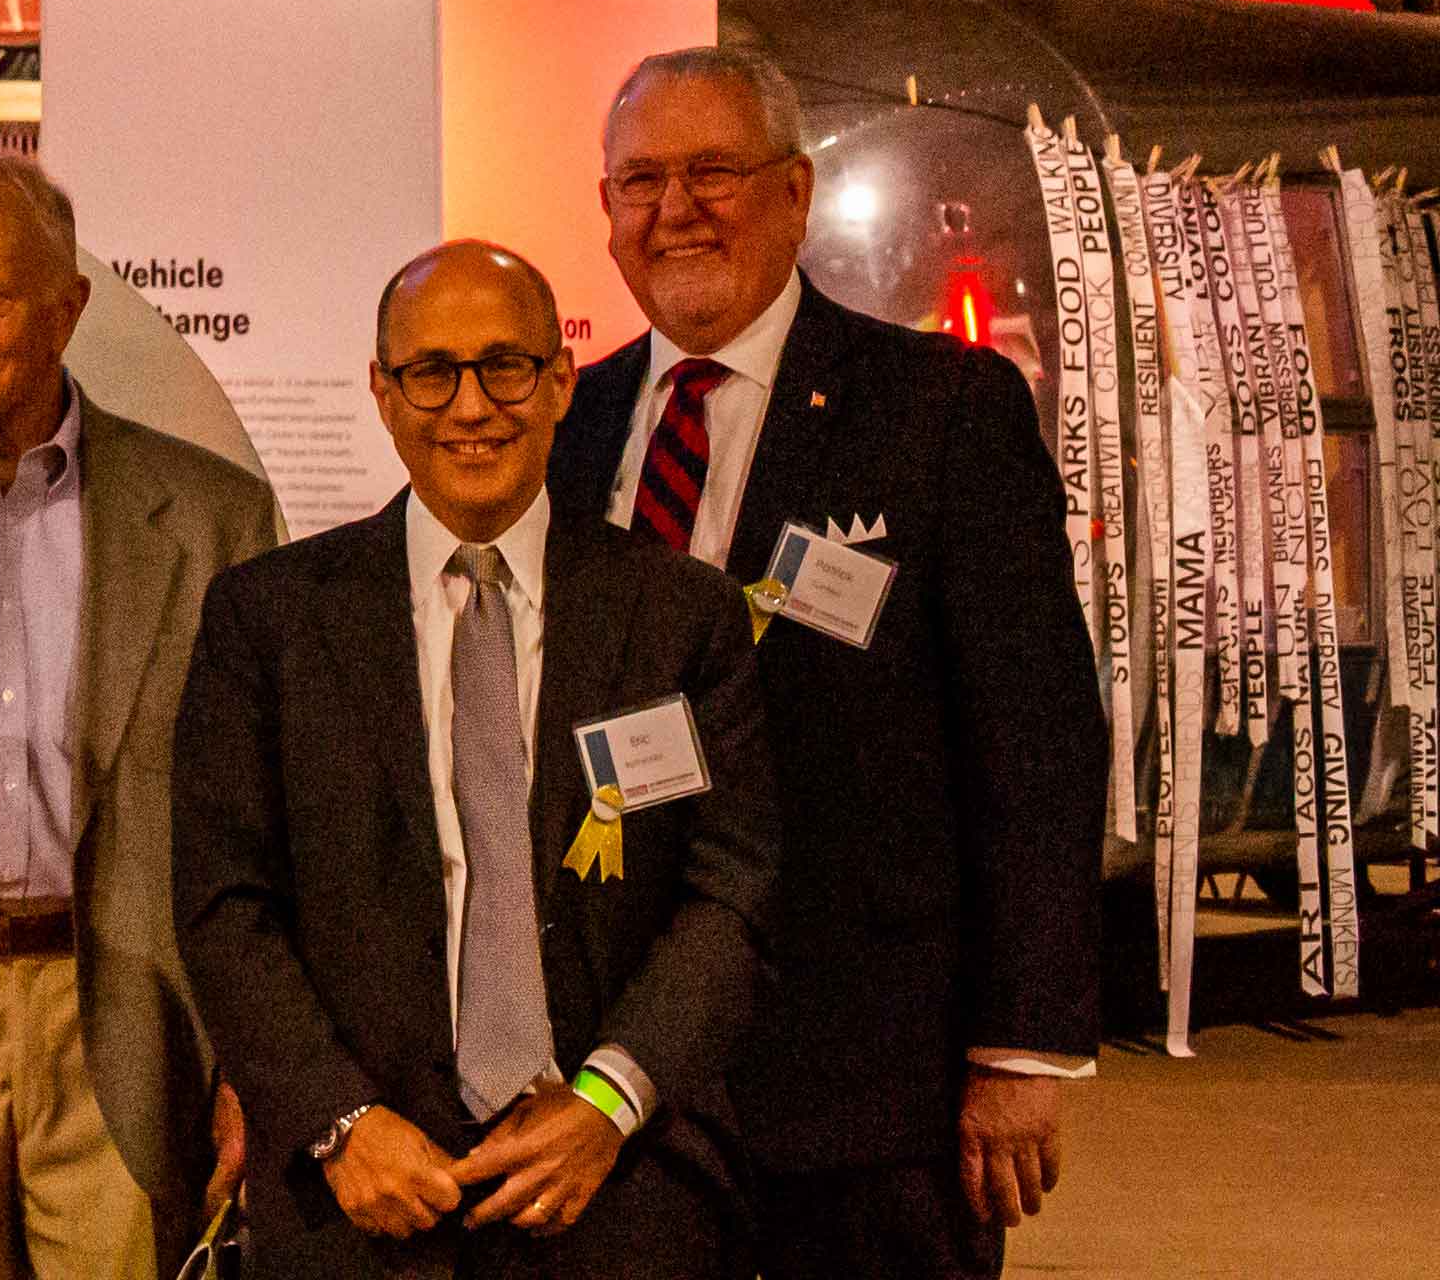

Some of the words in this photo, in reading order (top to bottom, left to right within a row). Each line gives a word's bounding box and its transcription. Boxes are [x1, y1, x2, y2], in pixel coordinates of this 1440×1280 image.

[1032, 127, 1074, 235] WALKING
[1067, 136, 1108, 253] PEOPLE
[112, 258, 224, 289] Vehicle
[1144, 181, 1186, 301] DIVERSITY
[1247, 184, 1278, 303] CULTURE
[1057, 256, 1086, 373] FOOD
[1086, 276, 1116, 393] CRACK
[1133, 299, 1159, 417] RESILIENT
[1243, 312, 1278, 425] VIBRANT
[1386, 307, 1411, 423] FROGS
[1403, 304, 1427, 421] DIVERSITY
[1230, 324, 1256, 435] DOGS
[1266, 323, 1298, 440] EXPRESSION
[1287, 324, 1317, 436] FOOD
[1064, 394, 1089, 517] PARKS
[1095, 416, 1122, 538] CREATIVITY
[1206, 443, 1226, 565] NEIGHBORS
[1268, 445, 1288, 563] BIKELANES
[1222, 459, 1235, 575] STORY
[1285, 463, 1305, 566] NICE
[1307, 458, 1329, 572] FRIENDS
[1108, 560, 1129, 685] STOOPS
[1175, 530, 1206, 650] MAMA
[1275, 583, 1298, 689] FUN
[1402, 575, 1424, 690] DIVERSITY
[1245, 599, 1266, 721] PEOPLE
[1315, 592, 1341, 711] DIVERSITY
[1295, 726, 1317, 839] TACOS
[1324, 732, 1351, 846] GIVING
[1410, 711, 1426, 831] COMMUNITY
[1300, 881, 1323, 988] ART
[1330, 866, 1359, 987] MONKEYS
